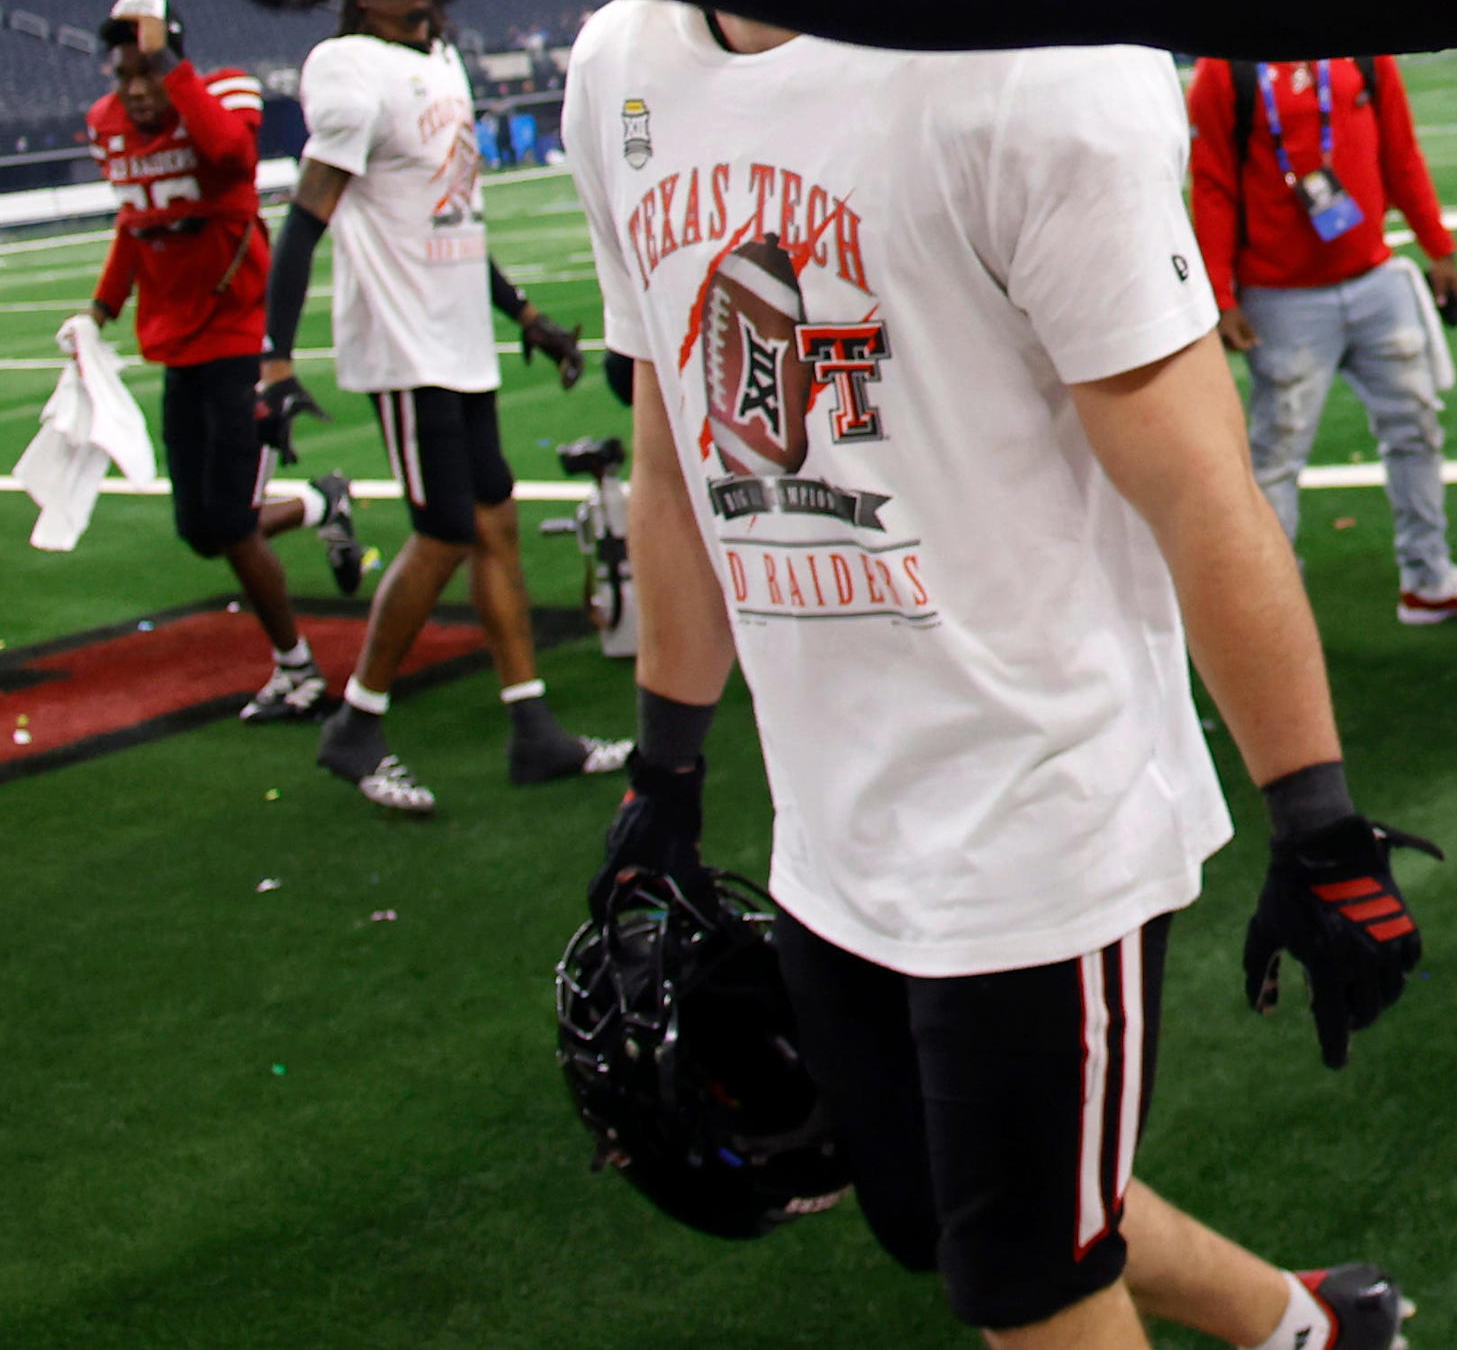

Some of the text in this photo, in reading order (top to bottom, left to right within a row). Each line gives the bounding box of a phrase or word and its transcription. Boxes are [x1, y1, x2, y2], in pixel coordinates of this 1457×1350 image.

[627, 162, 879, 296] TEXAS TECH
[763, 553, 929, 607] RAIDERS
